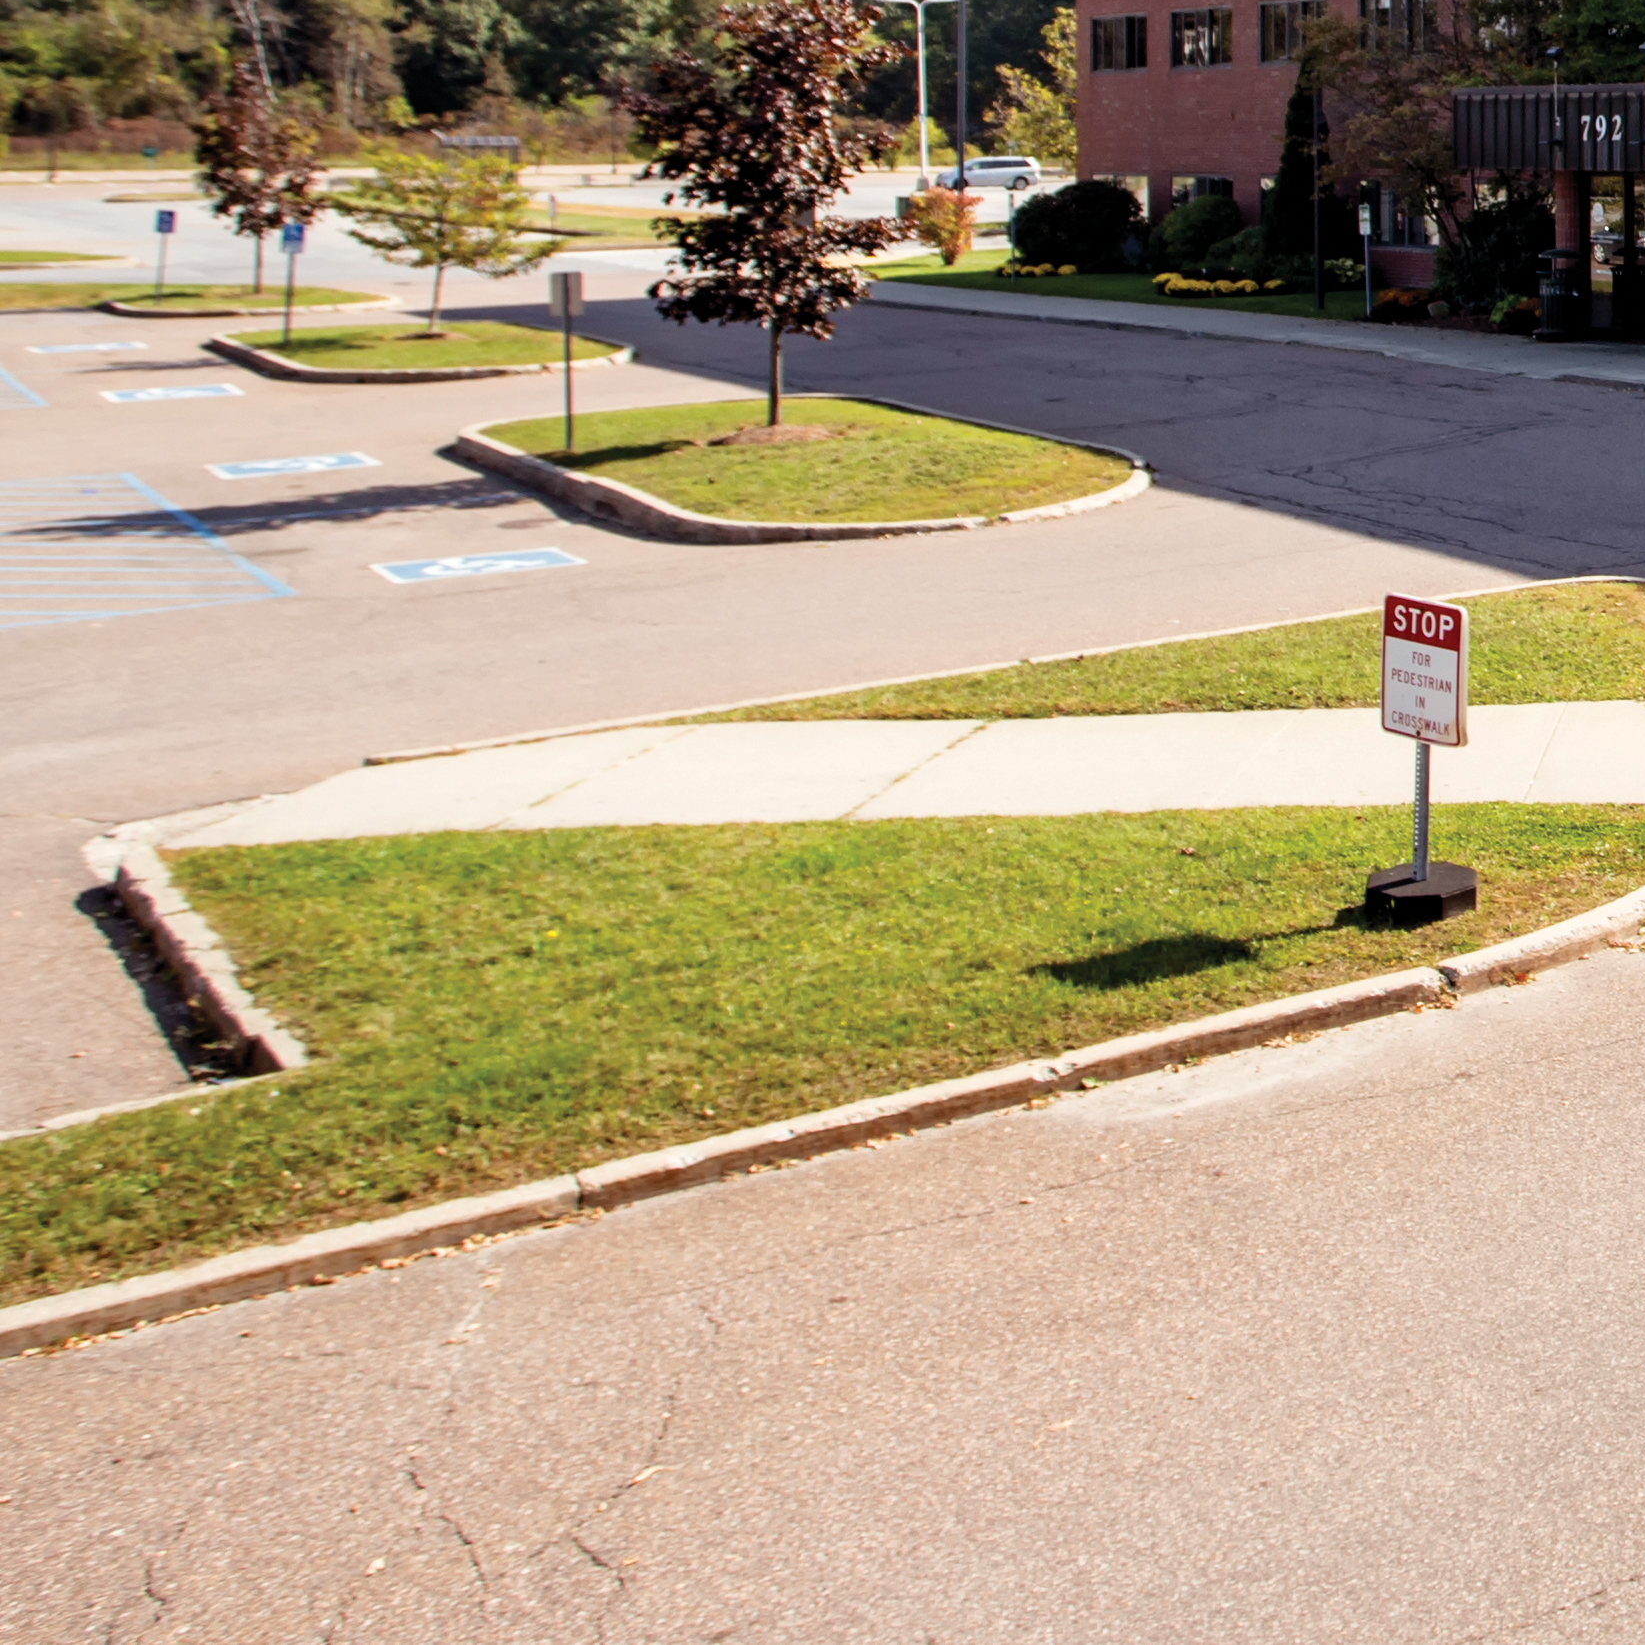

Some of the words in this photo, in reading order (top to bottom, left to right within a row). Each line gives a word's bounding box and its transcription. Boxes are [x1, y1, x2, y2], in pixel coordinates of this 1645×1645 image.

[1580, 114, 1623, 142] 792
[1393, 604, 1454, 640] STOP
[1411, 651, 1431, 668] FOR
[1391, 668, 1453, 694] PEDESTRIAN
[1415, 695, 1426, 709] IN
[1391, 710, 1450, 736] CROSSWALK
